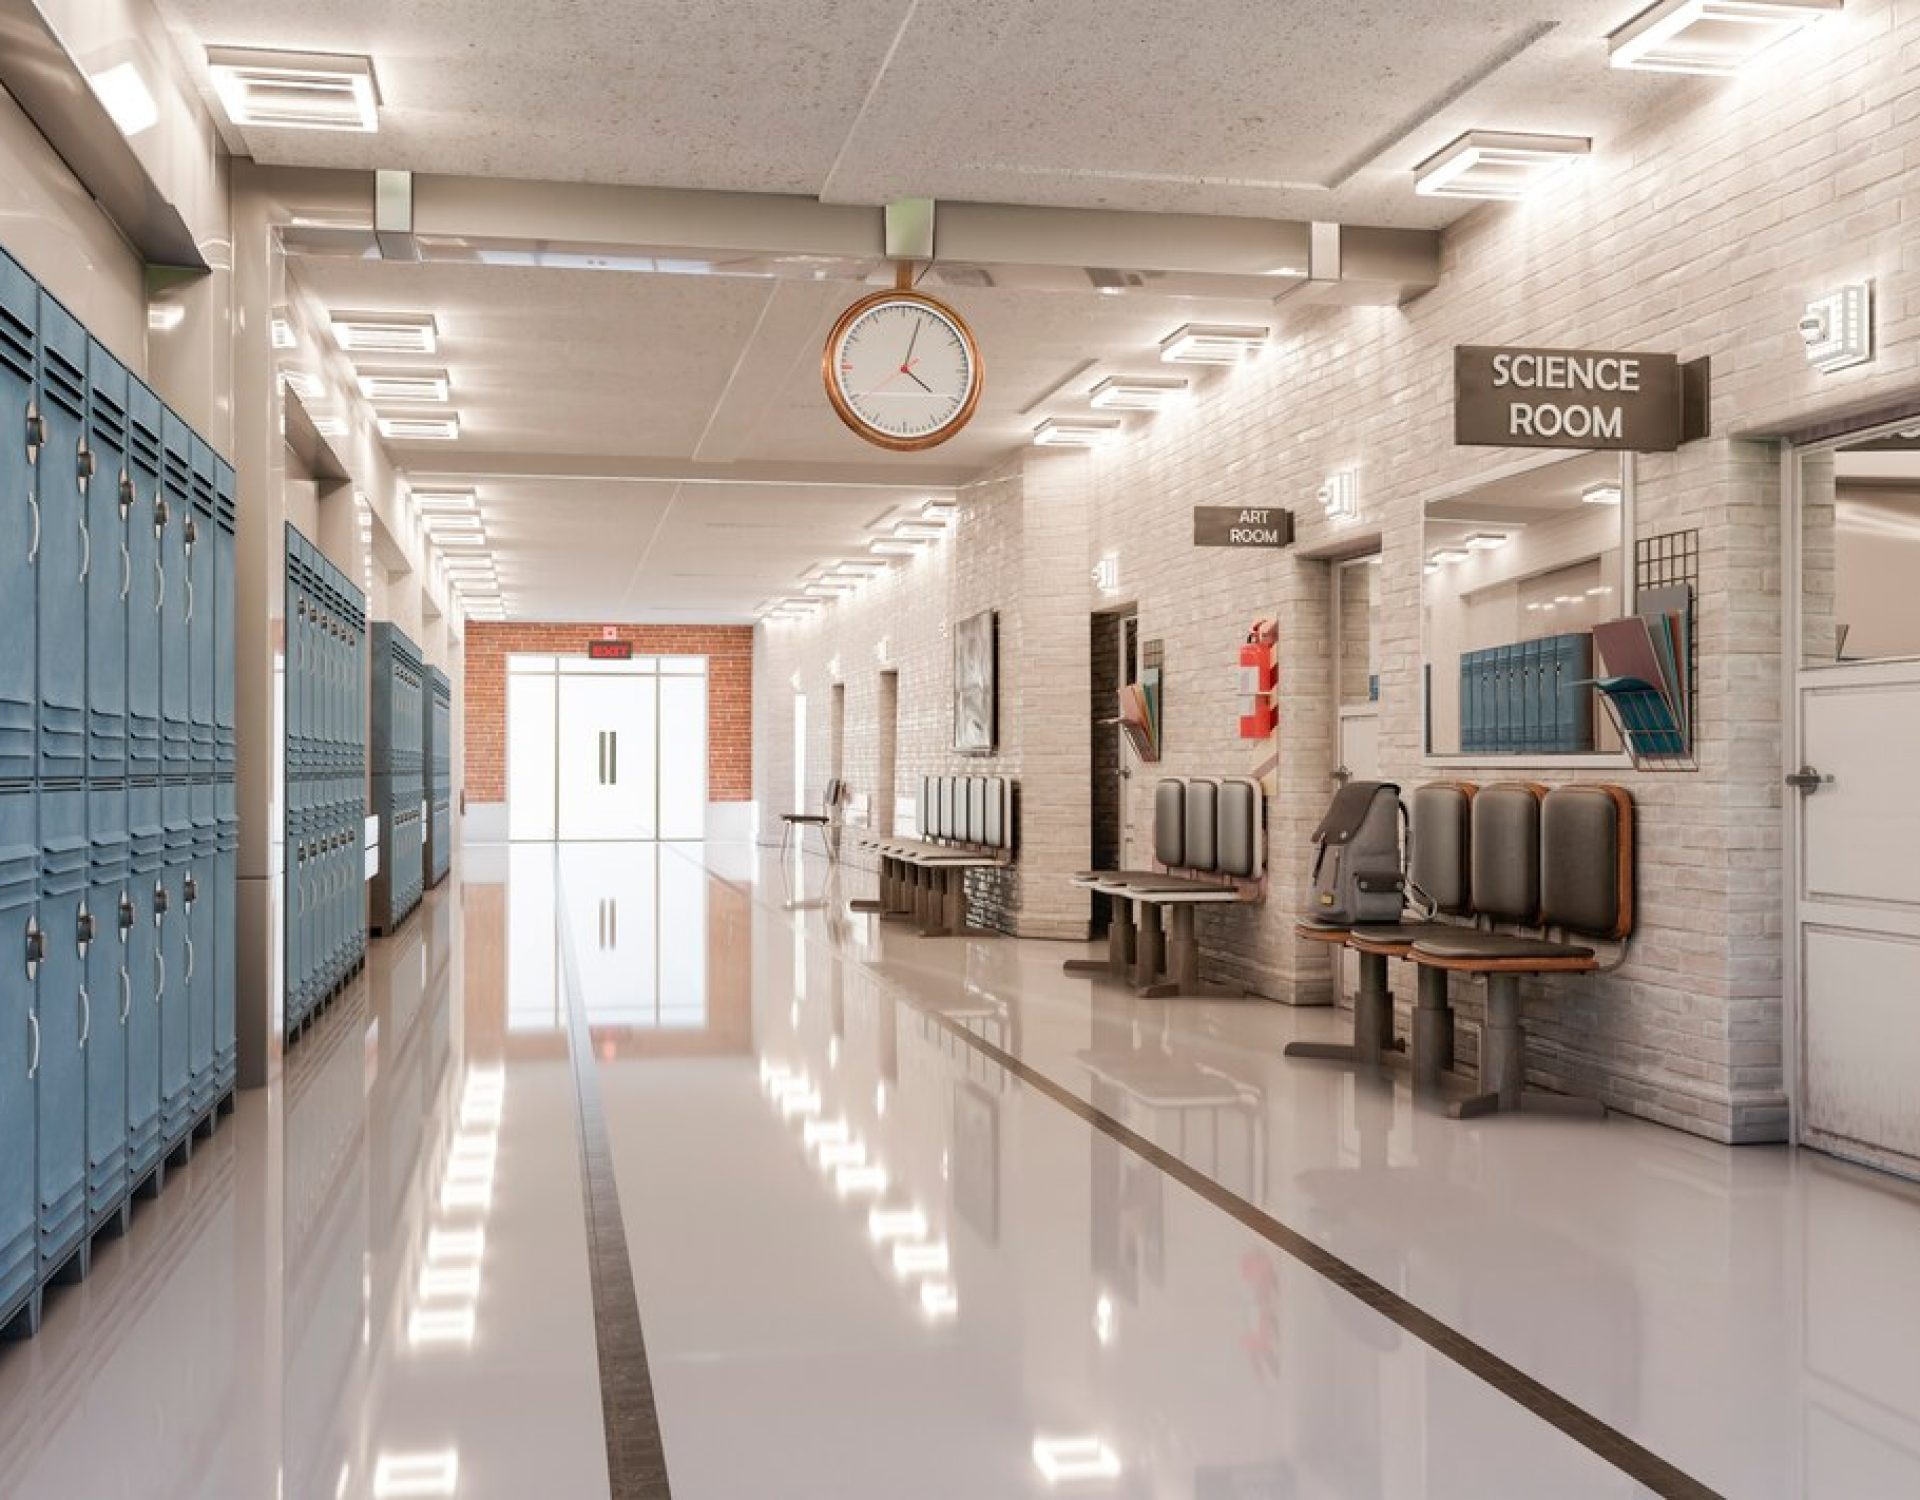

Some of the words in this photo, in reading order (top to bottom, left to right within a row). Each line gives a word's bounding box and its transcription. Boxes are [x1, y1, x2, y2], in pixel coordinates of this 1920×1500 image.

[1492, 353, 1640, 391] SCIENCE
[1509, 402, 1623, 438] ROOM
[1239, 509, 1269, 524] ART
[1229, 528, 1278, 543] ROOM
